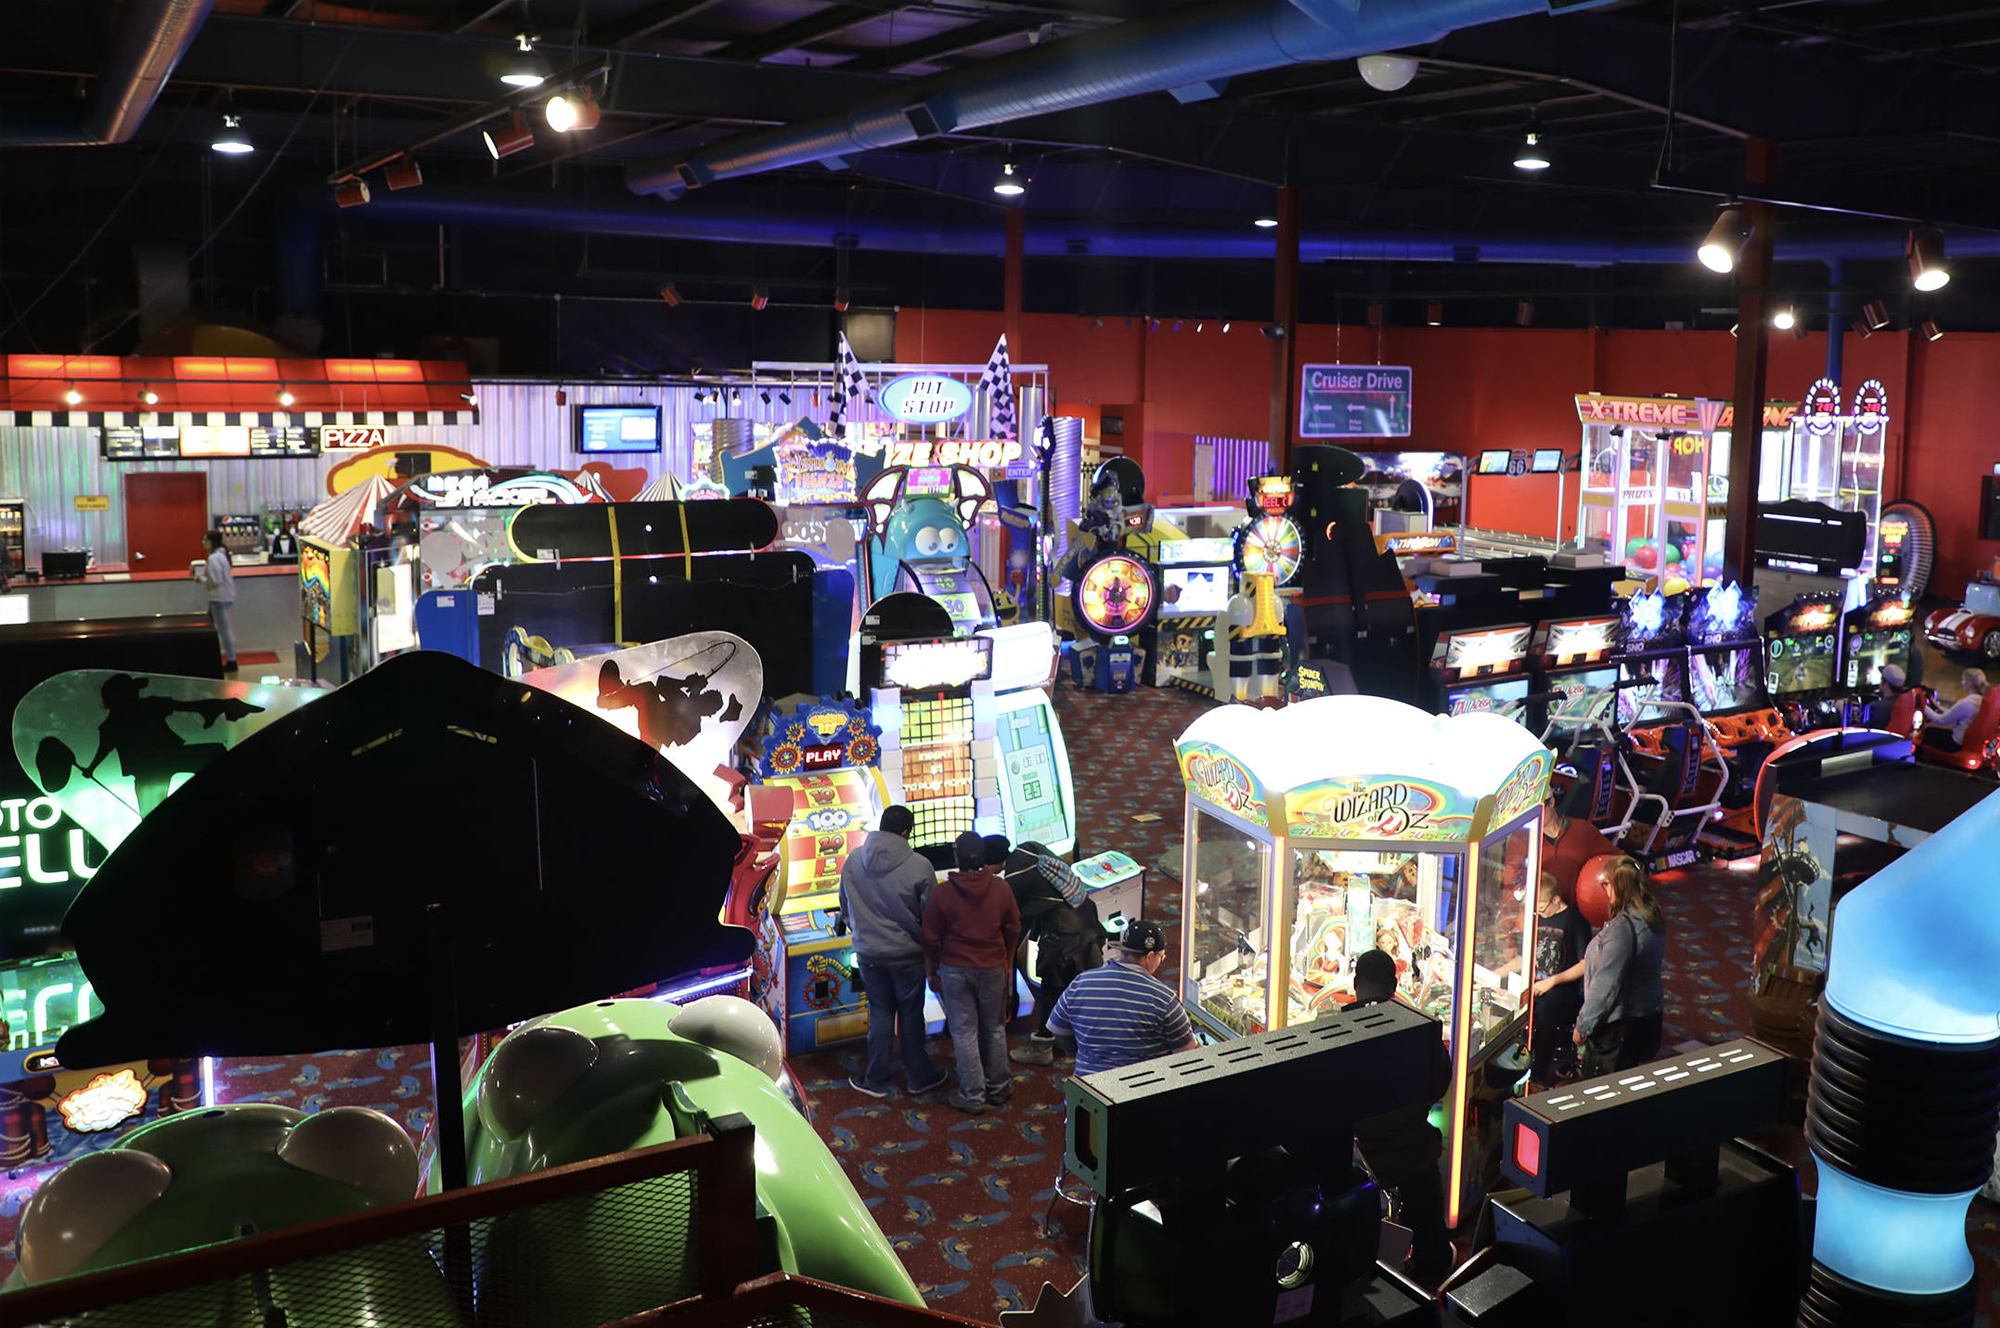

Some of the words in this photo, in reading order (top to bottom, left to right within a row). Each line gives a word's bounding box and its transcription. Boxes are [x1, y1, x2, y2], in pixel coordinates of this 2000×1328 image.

[912, 377, 945, 395] PIT
[1312, 371, 1363, 389] Cruiser
[1366, 372, 1403, 389] Drive
[902, 399, 956, 415] STOP
[1588, 399, 1687, 426] X-TREME
[324, 428, 386, 447] PIZZA
[937, 441, 1023, 467] SHOP
[1508, 460, 1525, 475] 66
[944, 599, 965, 614] 30
[1298, 665, 1321, 680] SPIDER
[805, 749, 842, 764] PLAY
[1350, 781, 1367, 793] The
[1322, 783, 1408, 824] WIZARD
[809, 809, 849, 830] 100
[1367, 811, 1380, 823] of
[822, 859, 838, 875] 5
[1666, 850, 1697, 868] NASCAR
